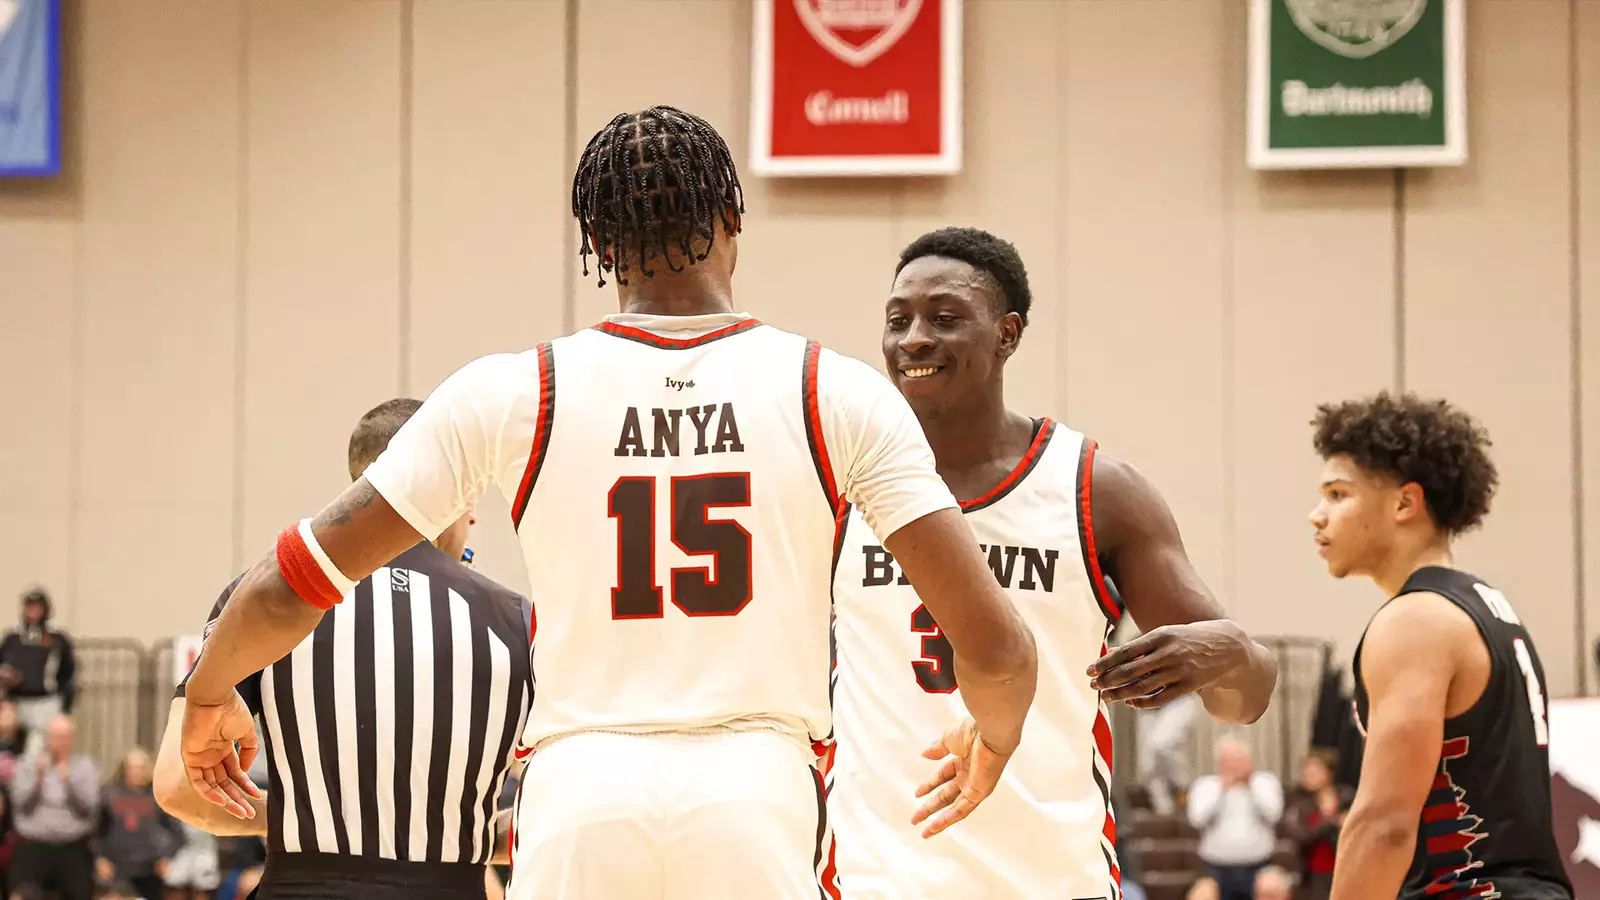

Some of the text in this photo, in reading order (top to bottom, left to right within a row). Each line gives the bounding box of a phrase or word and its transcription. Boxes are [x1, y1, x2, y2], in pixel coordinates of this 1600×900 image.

[1281, 78, 1433, 119] Dartmouth
[665, 376, 685, 392] Ivy
[614, 402, 745, 457] ANYA
[607, 472, 753, 620] 15
[862, 544, 1059, 593] BWN
